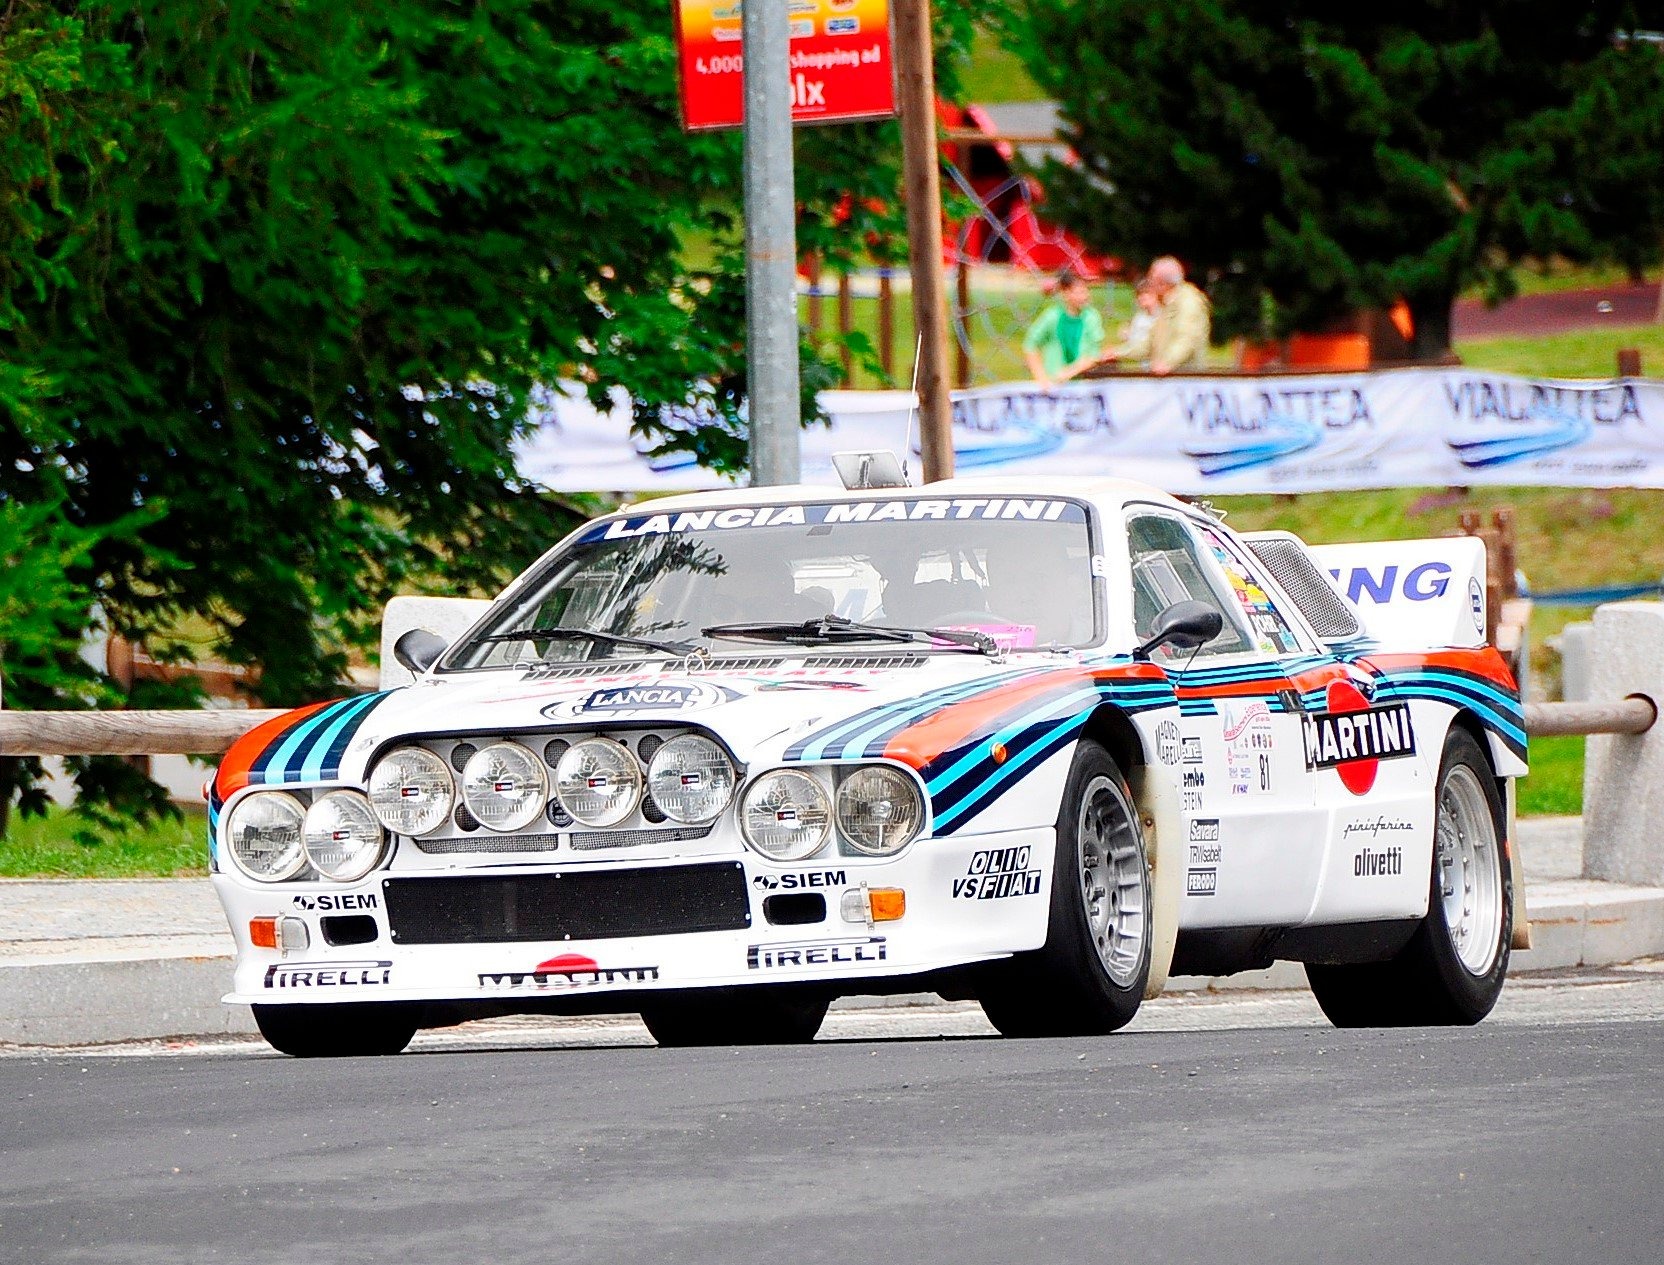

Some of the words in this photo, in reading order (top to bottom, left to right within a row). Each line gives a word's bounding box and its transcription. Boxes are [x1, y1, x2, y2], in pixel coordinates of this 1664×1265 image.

[861, 44, 881, 63] ad
[1179, 386, 1374, 433] VIALATTEA
[1443, 380, 1644, 424] VIALATTEA
[604, 505, 806, 540] LANCIA
[823, 499, 1067, 523] MARTINI
[591, 688, 684, 708] LANCIA
[1302, 707, 1412, 765] MARTINI
[1259, 753, 1271, 791] 81
[1343, 815, 1414, 839] pininfarina
[968, 845, 1031, 875] OLIO
[1354, 846, 1402, 877] olivetti
[780, 871, 847, 889] SIEM
[978, 870, 1042, 900] FIAT
[317, 894, 378, 910] SIEM
[746, 936, 887, 970] PIRELLI
[263, 960, 394, 989] PIRELLI
